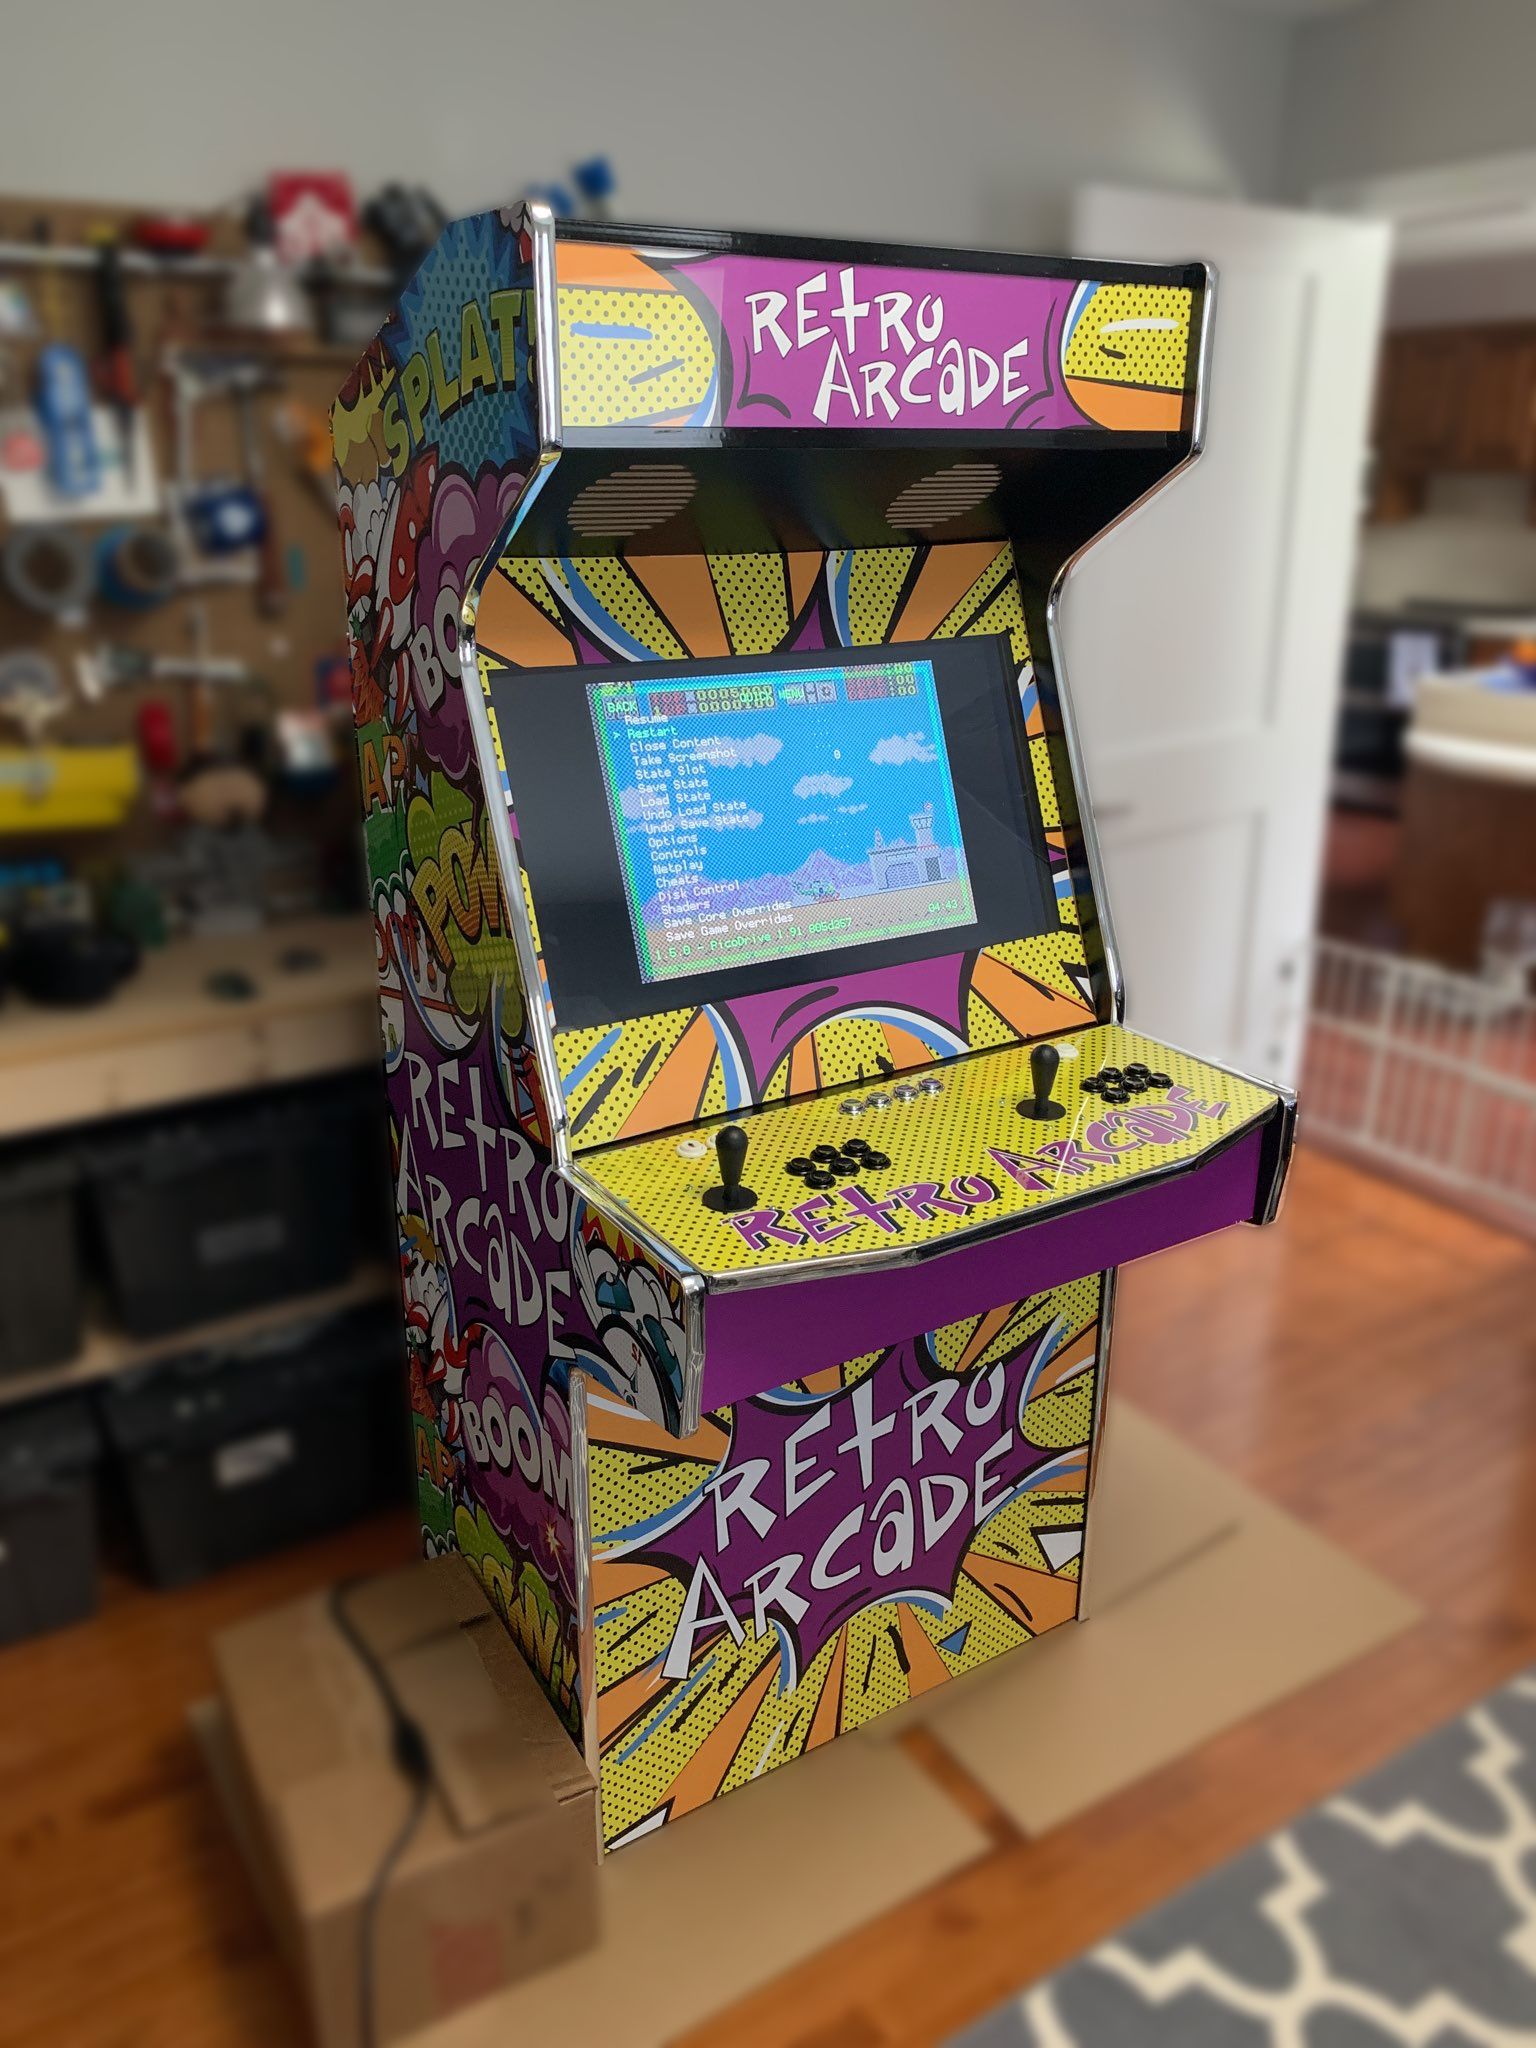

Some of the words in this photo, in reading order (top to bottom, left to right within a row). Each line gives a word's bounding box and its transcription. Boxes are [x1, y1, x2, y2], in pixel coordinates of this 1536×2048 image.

[606, 700, 637, 713] BACK
[624, 713, 669, 726] Resume
[627, 726, 678, 740] Restart
[630, 741, 667, 753] Close
[673, 736, 722, 749] Content
[632, 753, 662, 767] Take
[668, 747, 737, 762] Screenshot
[635, 768, 672, 780] State
[678, 763, 706, 776] Slot
[637, 783, 667, 794] Save
[673, 778, 709, 790] State
[640, 794, 670, 808] Load
[675, 791, 711, 803] State
[642, 809, 672, 821] Undo
[678, 803, 707, 817] Load
[712, 801, 747, 812] State
[645, 822, 675, 835] Undo
[680, 818, 709, 829] Save
[715, 813, 749, 826] State
[648, 833, 698, 849] Options
[650, 845, 707, 861] Controls
[653, 860, 703, 875] Netplay
[656, 874, 699, 889] Cheats
[659, 888, 687, 902] Disk
[693, 880, 740, 897] Control
[661, 900, 710, 916] Shaders
[663, 917, 692, 930] Save
[699, 912, 726, 924] Core
[732, 900, 792, 918] Overrides
[666, 930, 695, 942] Save
[701, 924, 729, 936] Game
[735, 913, 794, 931] Overrides
[710, 932, 771, 951] PicoDrive
